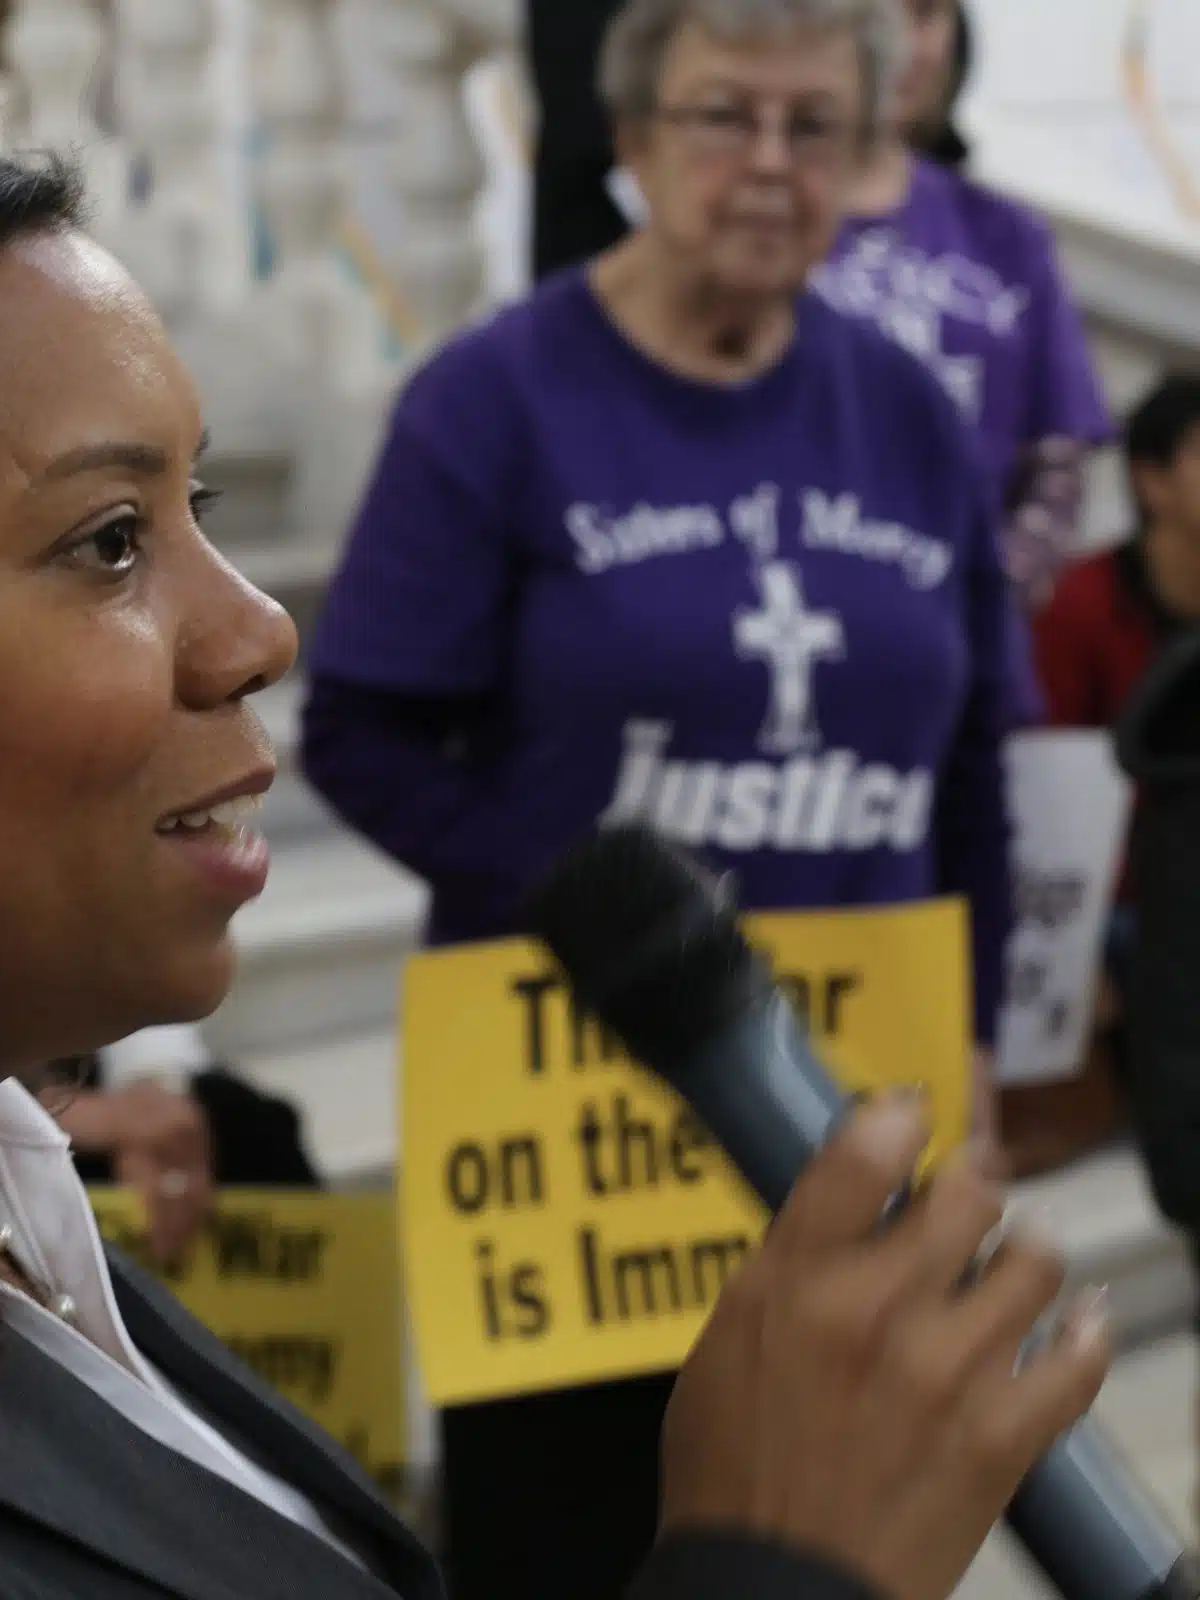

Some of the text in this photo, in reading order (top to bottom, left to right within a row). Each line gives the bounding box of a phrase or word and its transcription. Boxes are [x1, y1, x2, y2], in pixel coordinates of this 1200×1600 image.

[446, 1092, 702, 1215] on the
[477, 1220, 750, 1342] is Imm
